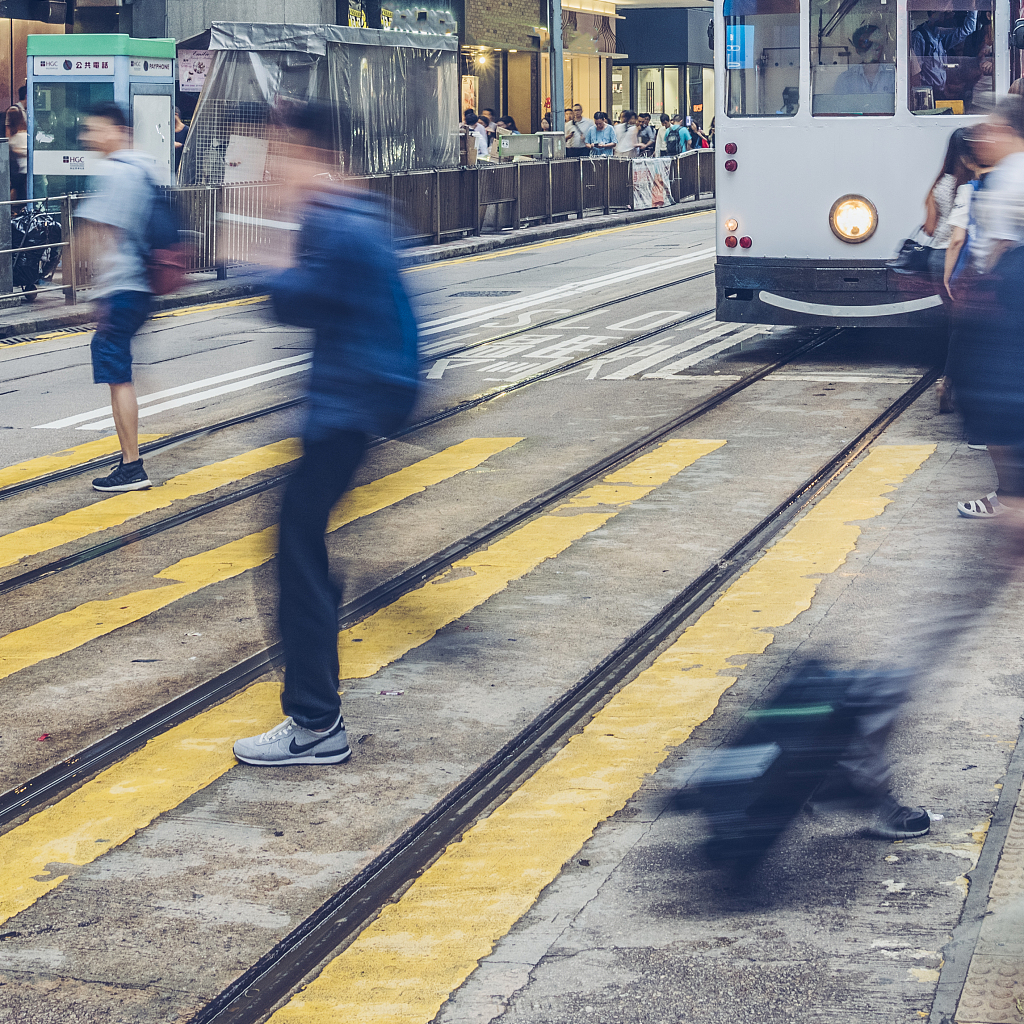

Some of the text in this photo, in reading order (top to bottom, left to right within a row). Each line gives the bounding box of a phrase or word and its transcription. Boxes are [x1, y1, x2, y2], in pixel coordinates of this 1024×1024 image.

[75, 61, 109, 69] 公共電話
[149, 63, 170, 71] PAYPHONE
